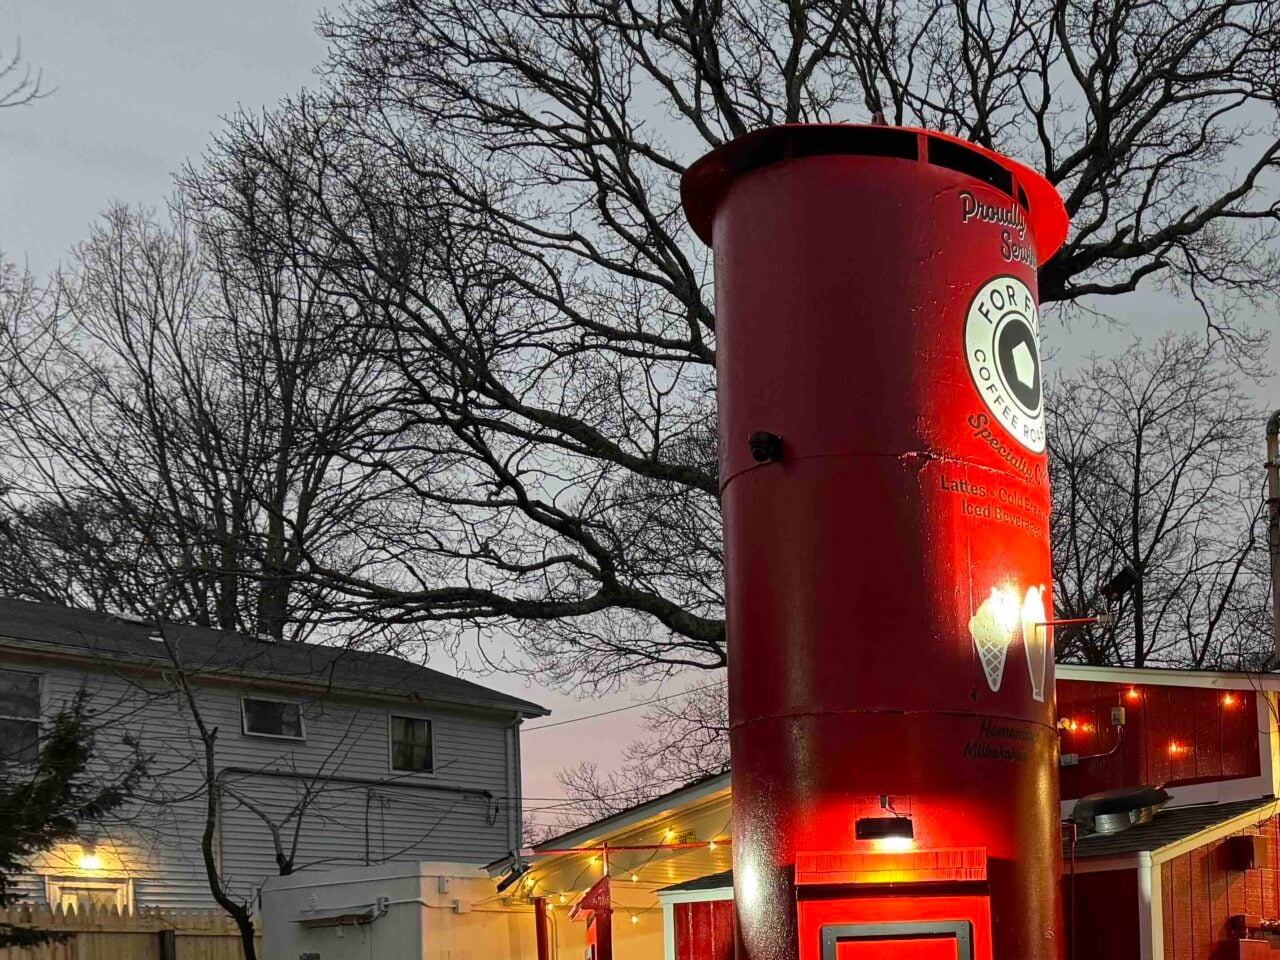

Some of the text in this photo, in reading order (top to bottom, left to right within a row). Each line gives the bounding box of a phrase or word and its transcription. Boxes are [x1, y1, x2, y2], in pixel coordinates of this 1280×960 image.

[959, 191, 1027, 240] Proudly
[977, 284, 1017, 324] FOR
[974, 348, 1019, 430] COFFEE
[968, 413, 1033, 482] Specialty
[941, 475, 986, 497] Lattes
[999, 487, 1024, 509] Cold
[962, 499, 991, 518] Iced
